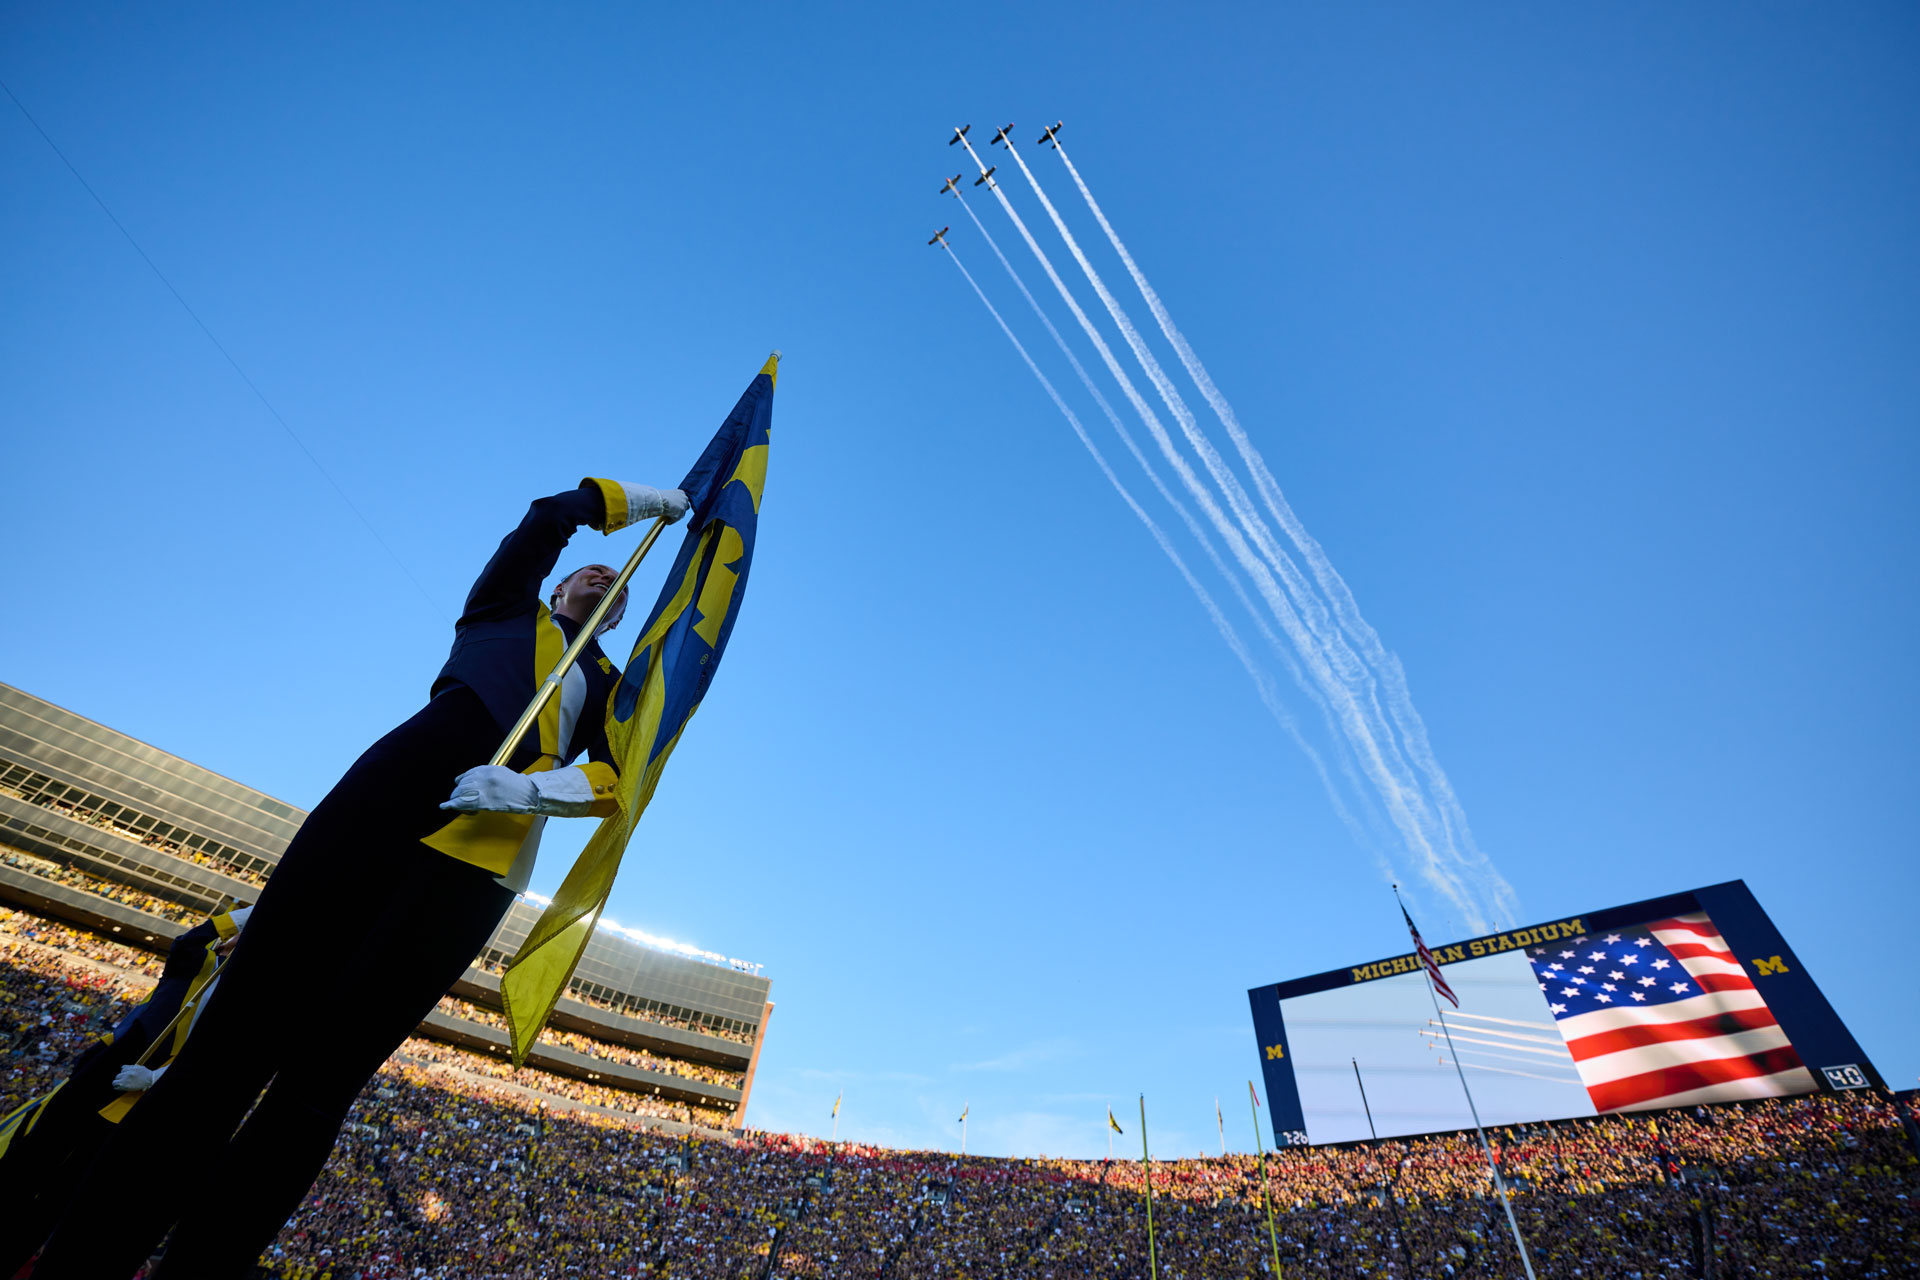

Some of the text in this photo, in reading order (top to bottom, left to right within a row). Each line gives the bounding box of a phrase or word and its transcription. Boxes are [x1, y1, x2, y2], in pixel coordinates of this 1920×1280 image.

[1469, 919, 1586, 957] STADIUM
[1751, 955, 1789, 976] M
[1265, 1044, 1284, 1060] M
[1827, 1067, 1863, 1086] 40
